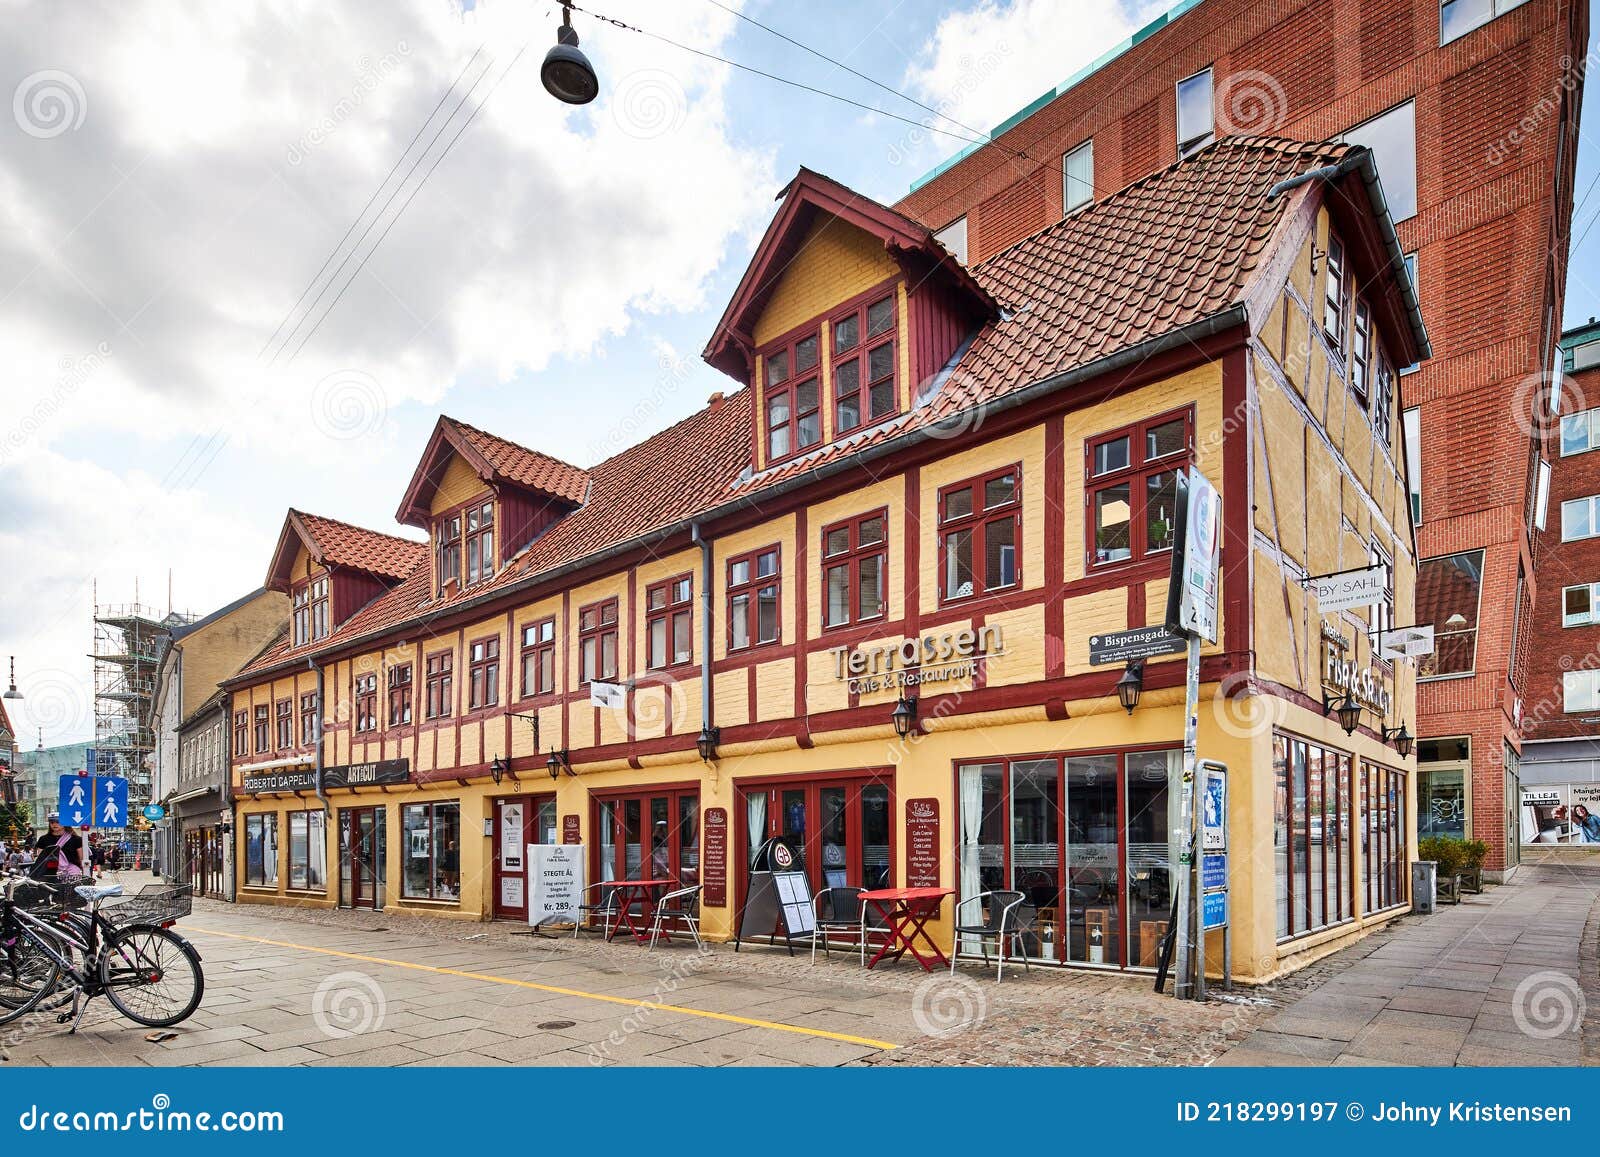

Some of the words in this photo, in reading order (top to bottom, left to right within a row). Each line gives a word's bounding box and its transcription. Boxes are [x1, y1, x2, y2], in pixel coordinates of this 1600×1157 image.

[1319, 583, 1337, 598] BY
[1343, 577, 1381, 593] SAHL
[1105, 627, 1170, 647] Bispensgade
[829, 623, 1004, 679] Terrassen
[882, 674, 895, 689] &
[898, 660, 978, 687] Restaurant
[244, 777, 277, 790] ROBERTO
[347, 766, 360, 783] ART
[513, 782, 522, 793] 31
[543, 903, 554, 911] Kr.
[555, 902, 574, 910] 289,-
